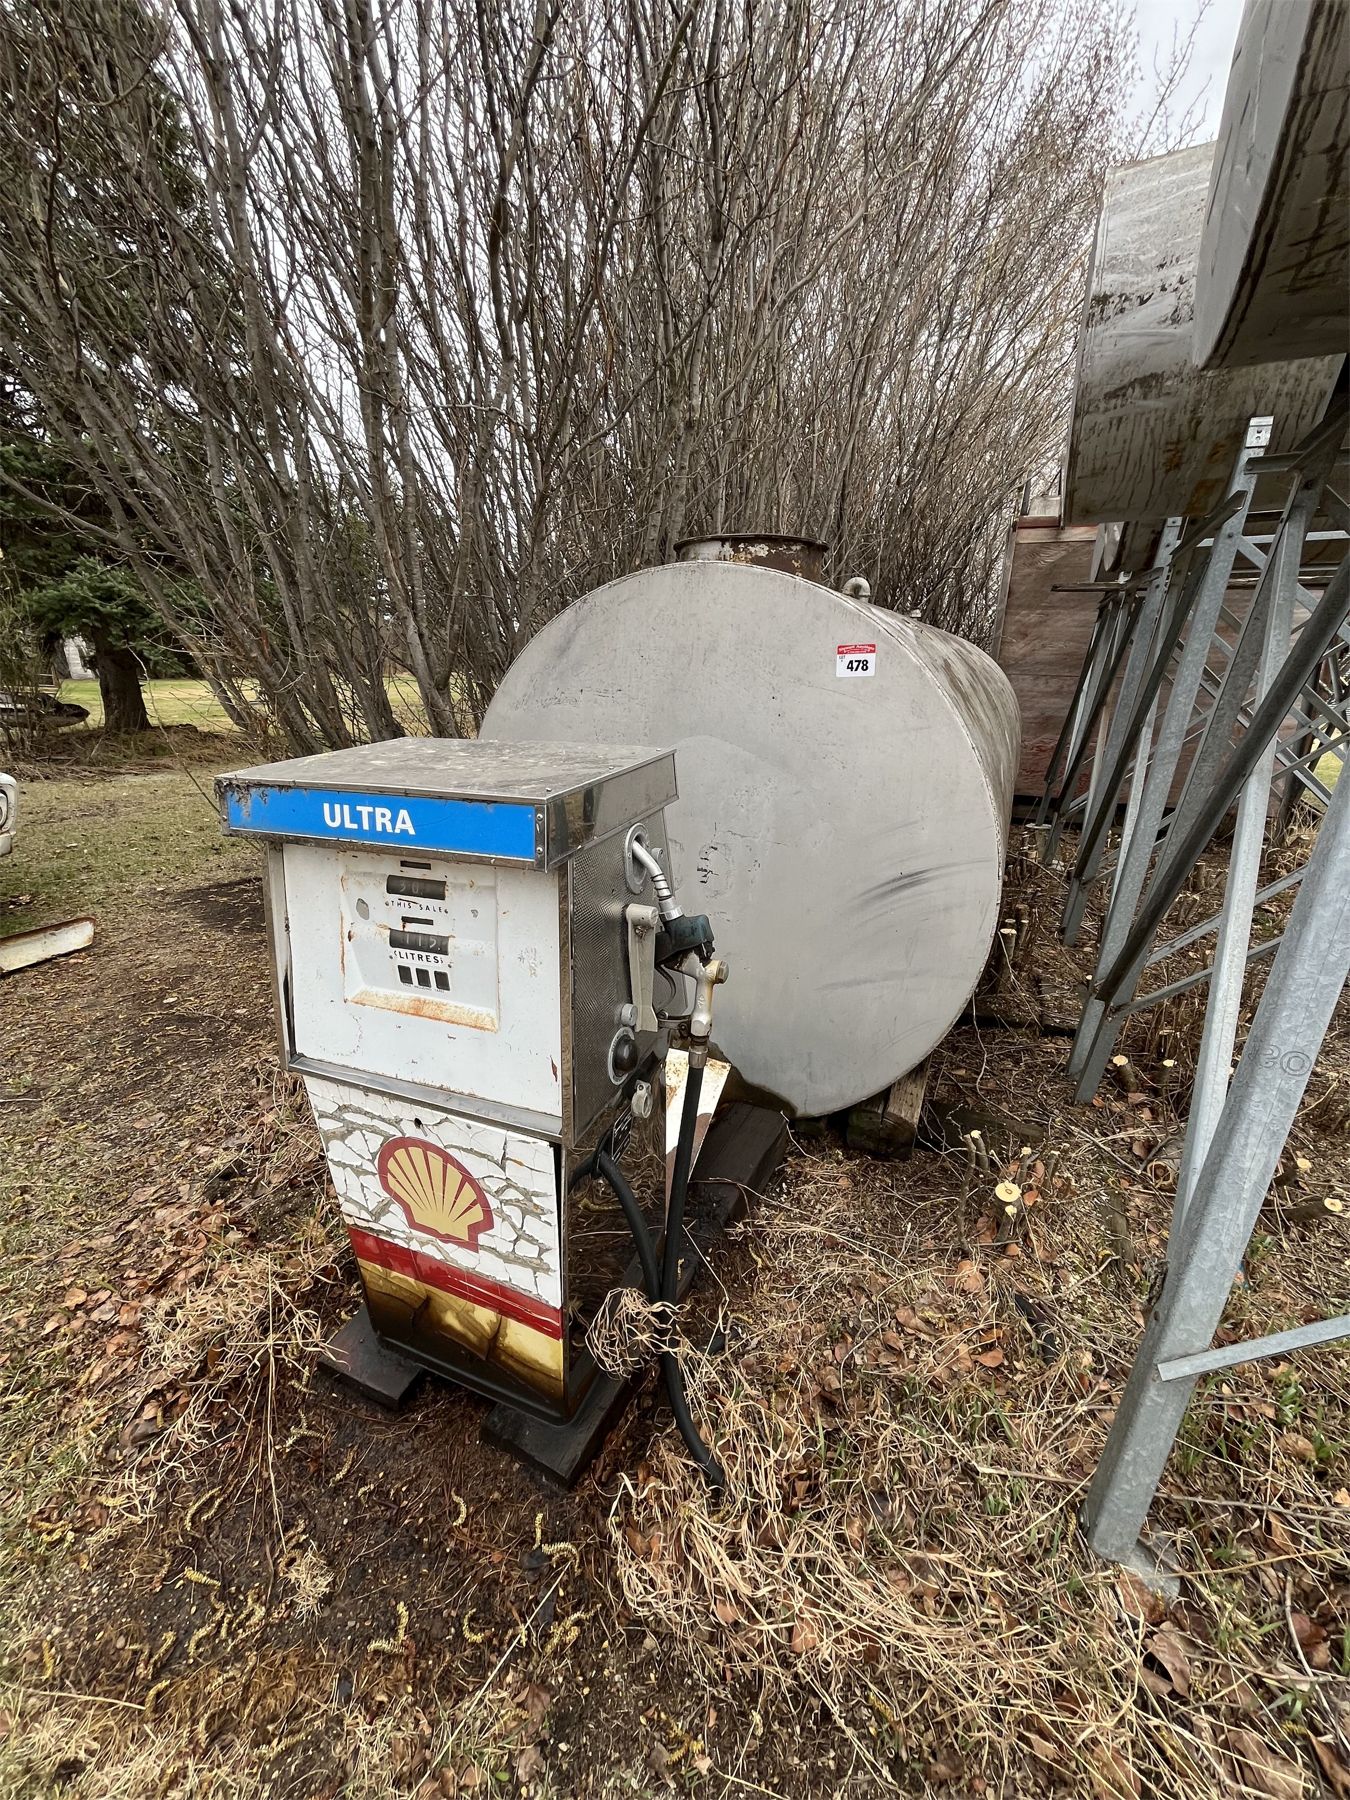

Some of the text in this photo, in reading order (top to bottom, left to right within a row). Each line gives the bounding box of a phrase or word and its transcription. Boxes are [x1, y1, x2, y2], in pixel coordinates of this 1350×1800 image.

[847, 659, 869, 672] 478
[322, 803, 416, 835] ULTRA
[391, 901, 443, 913] THIS SALE
